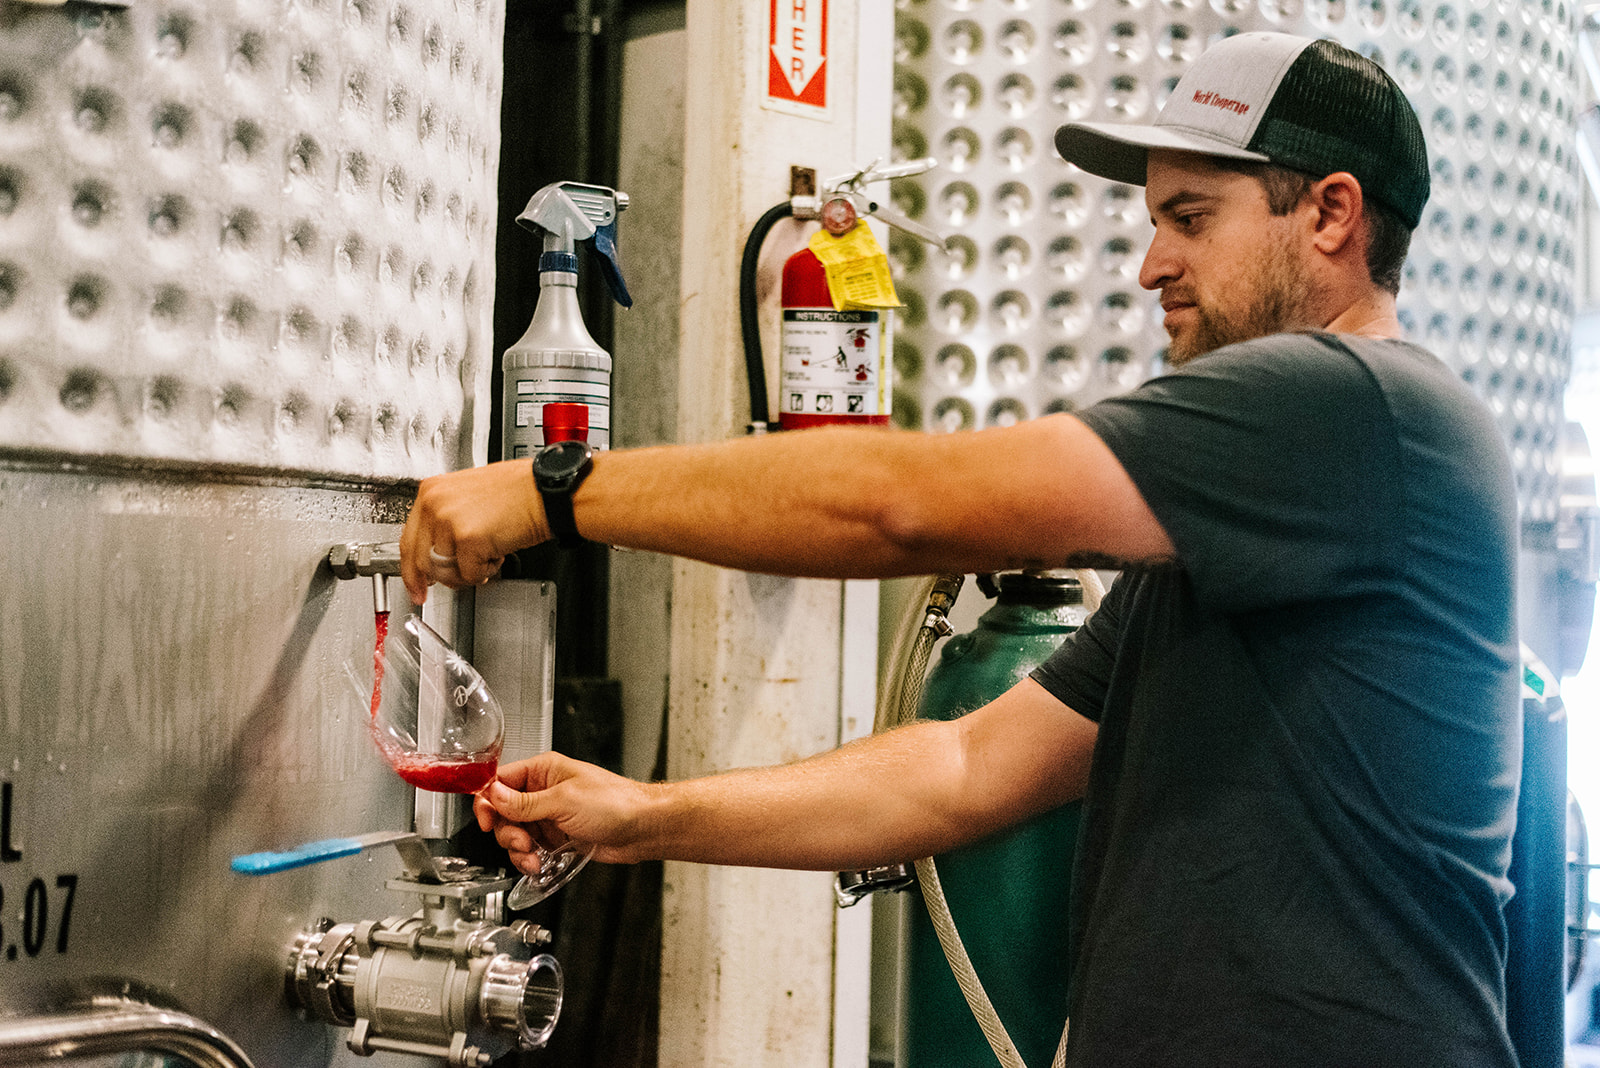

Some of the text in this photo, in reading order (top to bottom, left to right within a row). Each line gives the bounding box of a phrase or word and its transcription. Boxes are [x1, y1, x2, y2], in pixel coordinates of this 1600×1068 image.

[1192, 90, 1249, 115] World Cooperage
[796, 312, 861, 321] INSTRUCTIONS
[0, 874, 78, 961] .07
